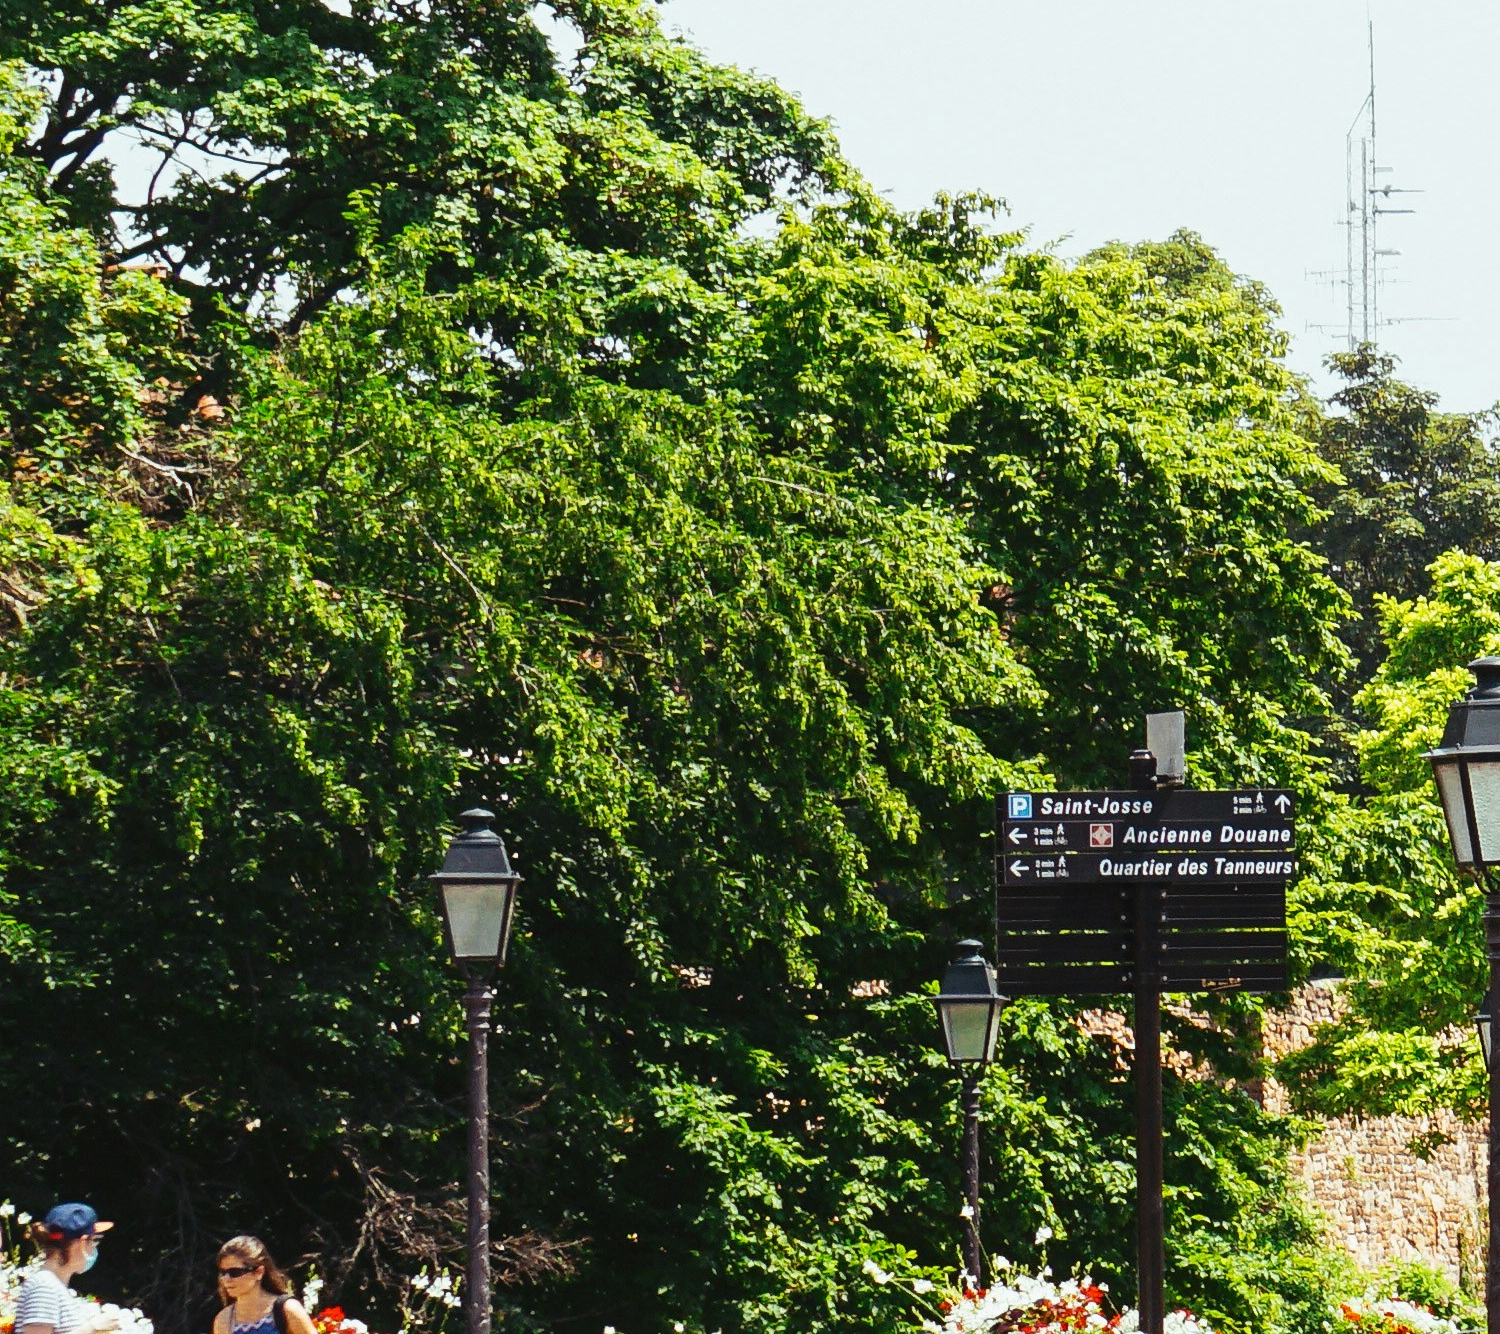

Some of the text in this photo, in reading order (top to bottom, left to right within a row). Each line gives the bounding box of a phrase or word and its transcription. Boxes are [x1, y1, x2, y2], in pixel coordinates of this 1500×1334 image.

[1012, 797, 1153, 816] P Saint-Josse
[1123, 825, 1291, 844] Ancienne Douane
[1099, 857, 1292, 876] Quartier des Tanneurs
